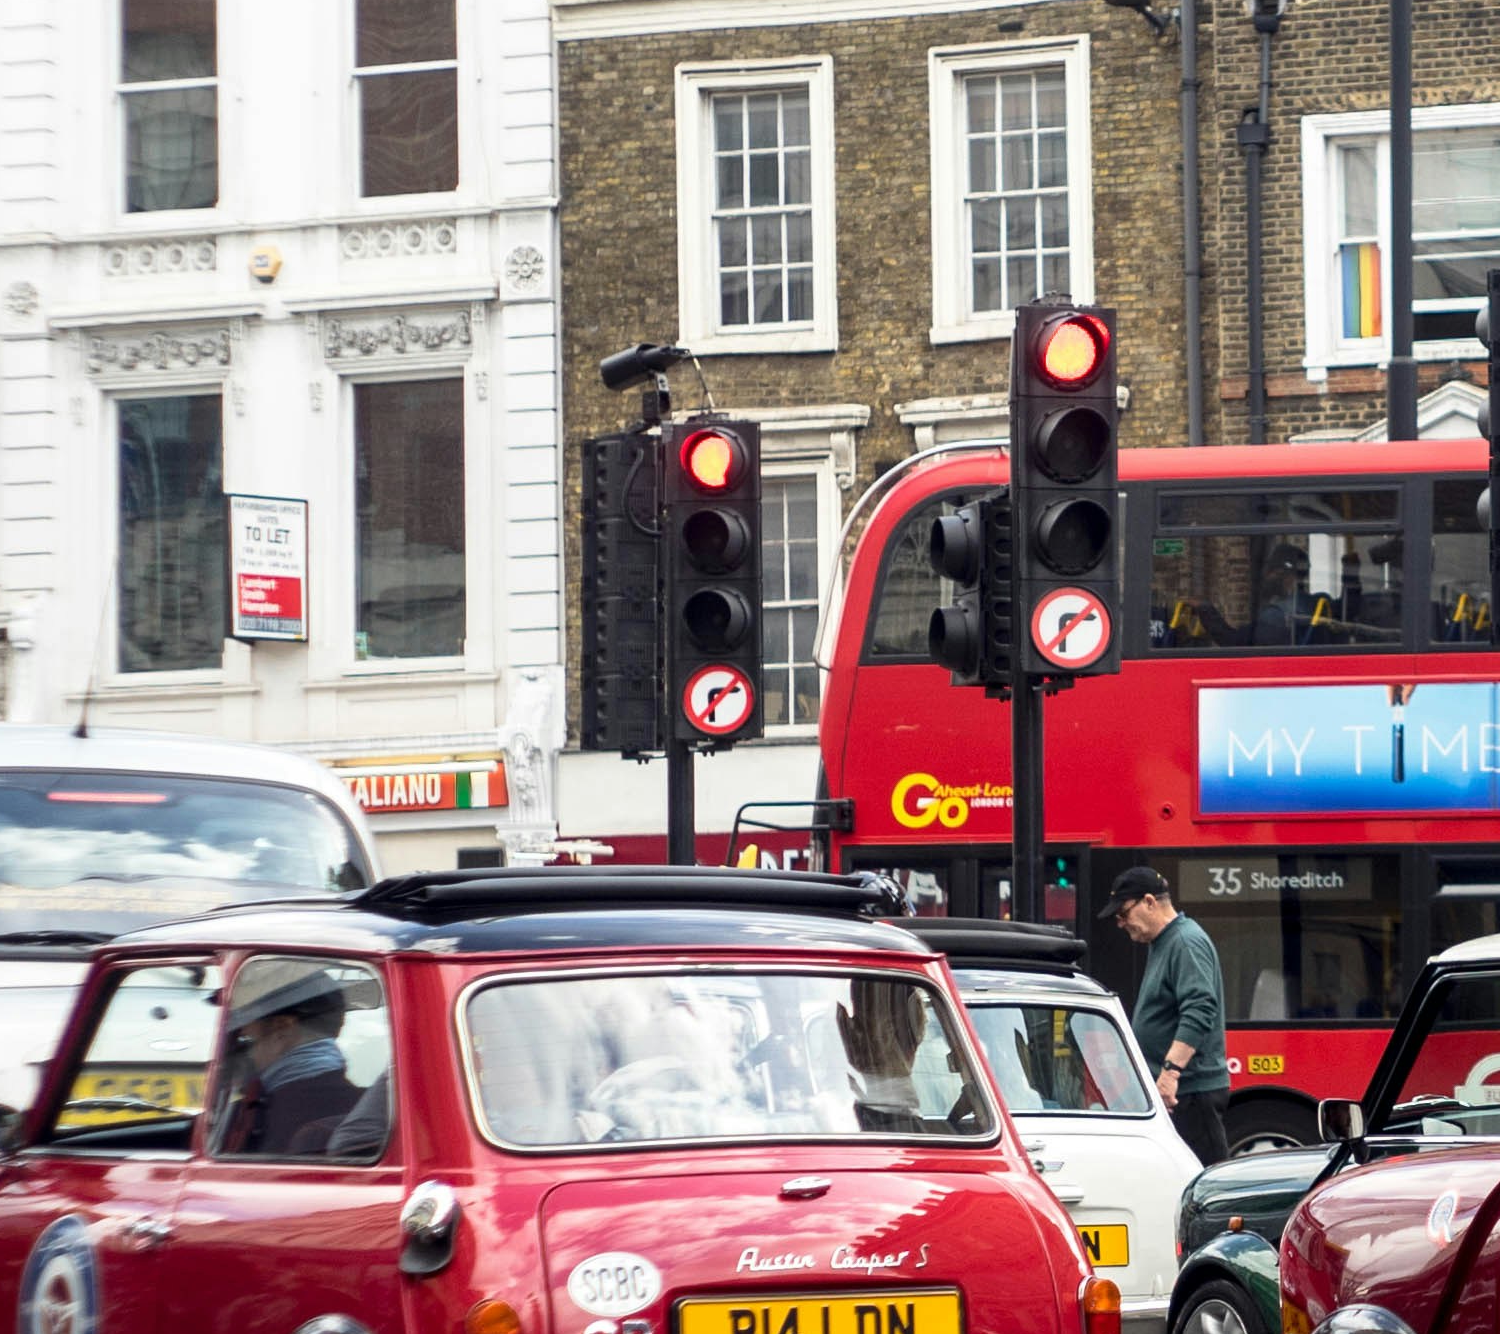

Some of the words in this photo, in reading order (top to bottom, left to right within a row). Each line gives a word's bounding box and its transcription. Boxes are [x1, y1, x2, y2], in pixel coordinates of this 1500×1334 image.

[245, 526, 261, 542] TO
[267, 528, 291, 544] LET
[1226, 725, 1315, 778] MY
[891, 772, 969, 828] Go
[1208, 867, 1242, 896] 35
[1250, 871, 1344, 890] Shoreditch
[1252, 1057, 1281, 1072] 503
[736, 1245, 816, 1273] Austin
[829, 1245, 909, 1275] Cooper
[916, 1243, 931, 1268] S
[582, 1264, 649, 1304] SCBC
